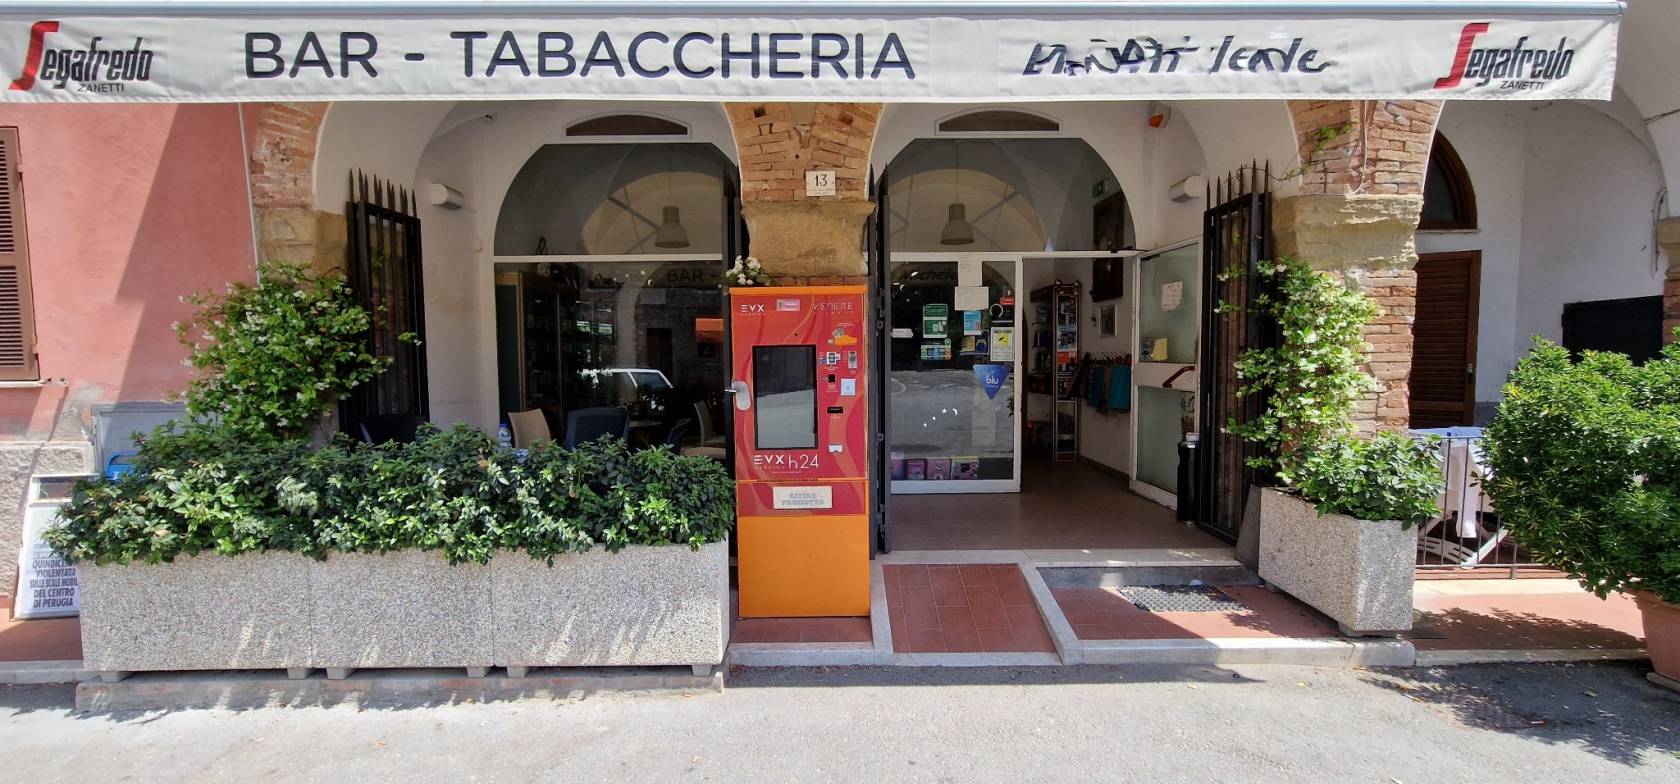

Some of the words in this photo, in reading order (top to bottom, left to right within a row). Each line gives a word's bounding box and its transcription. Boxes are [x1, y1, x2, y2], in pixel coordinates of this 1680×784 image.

[8, 21, 153, 90] Segafredo
[245, 32, 378, 78] BAR
[404, 52, 424, 61] -
[450, 31, 916, 79] TABACCHERIA
[1434, 22, 1575, 89] Segafredo
[77, 83, 124, 93] ZANETTI
[1500, 79, 1544, 90] ZANETTI
[815, 174, 828, 187] 13
[741, 304, 765, 312] EVX
[985, 375, 999, 384] blu
[754, 454, 784, 465] EVX
[788, 453, 819, 469] h24
[35, 568, 77, 578] VIOLENTATA
[30, 579, 45, 588] SULLE
[46, 578, 60, 587] SCALE
[34, 589, 47, 598] DEL
[48, 588, 75, 598] CENTRO
[33, 599, 42, 608] DI
[42, 598, 74, 608] PERUGIA
